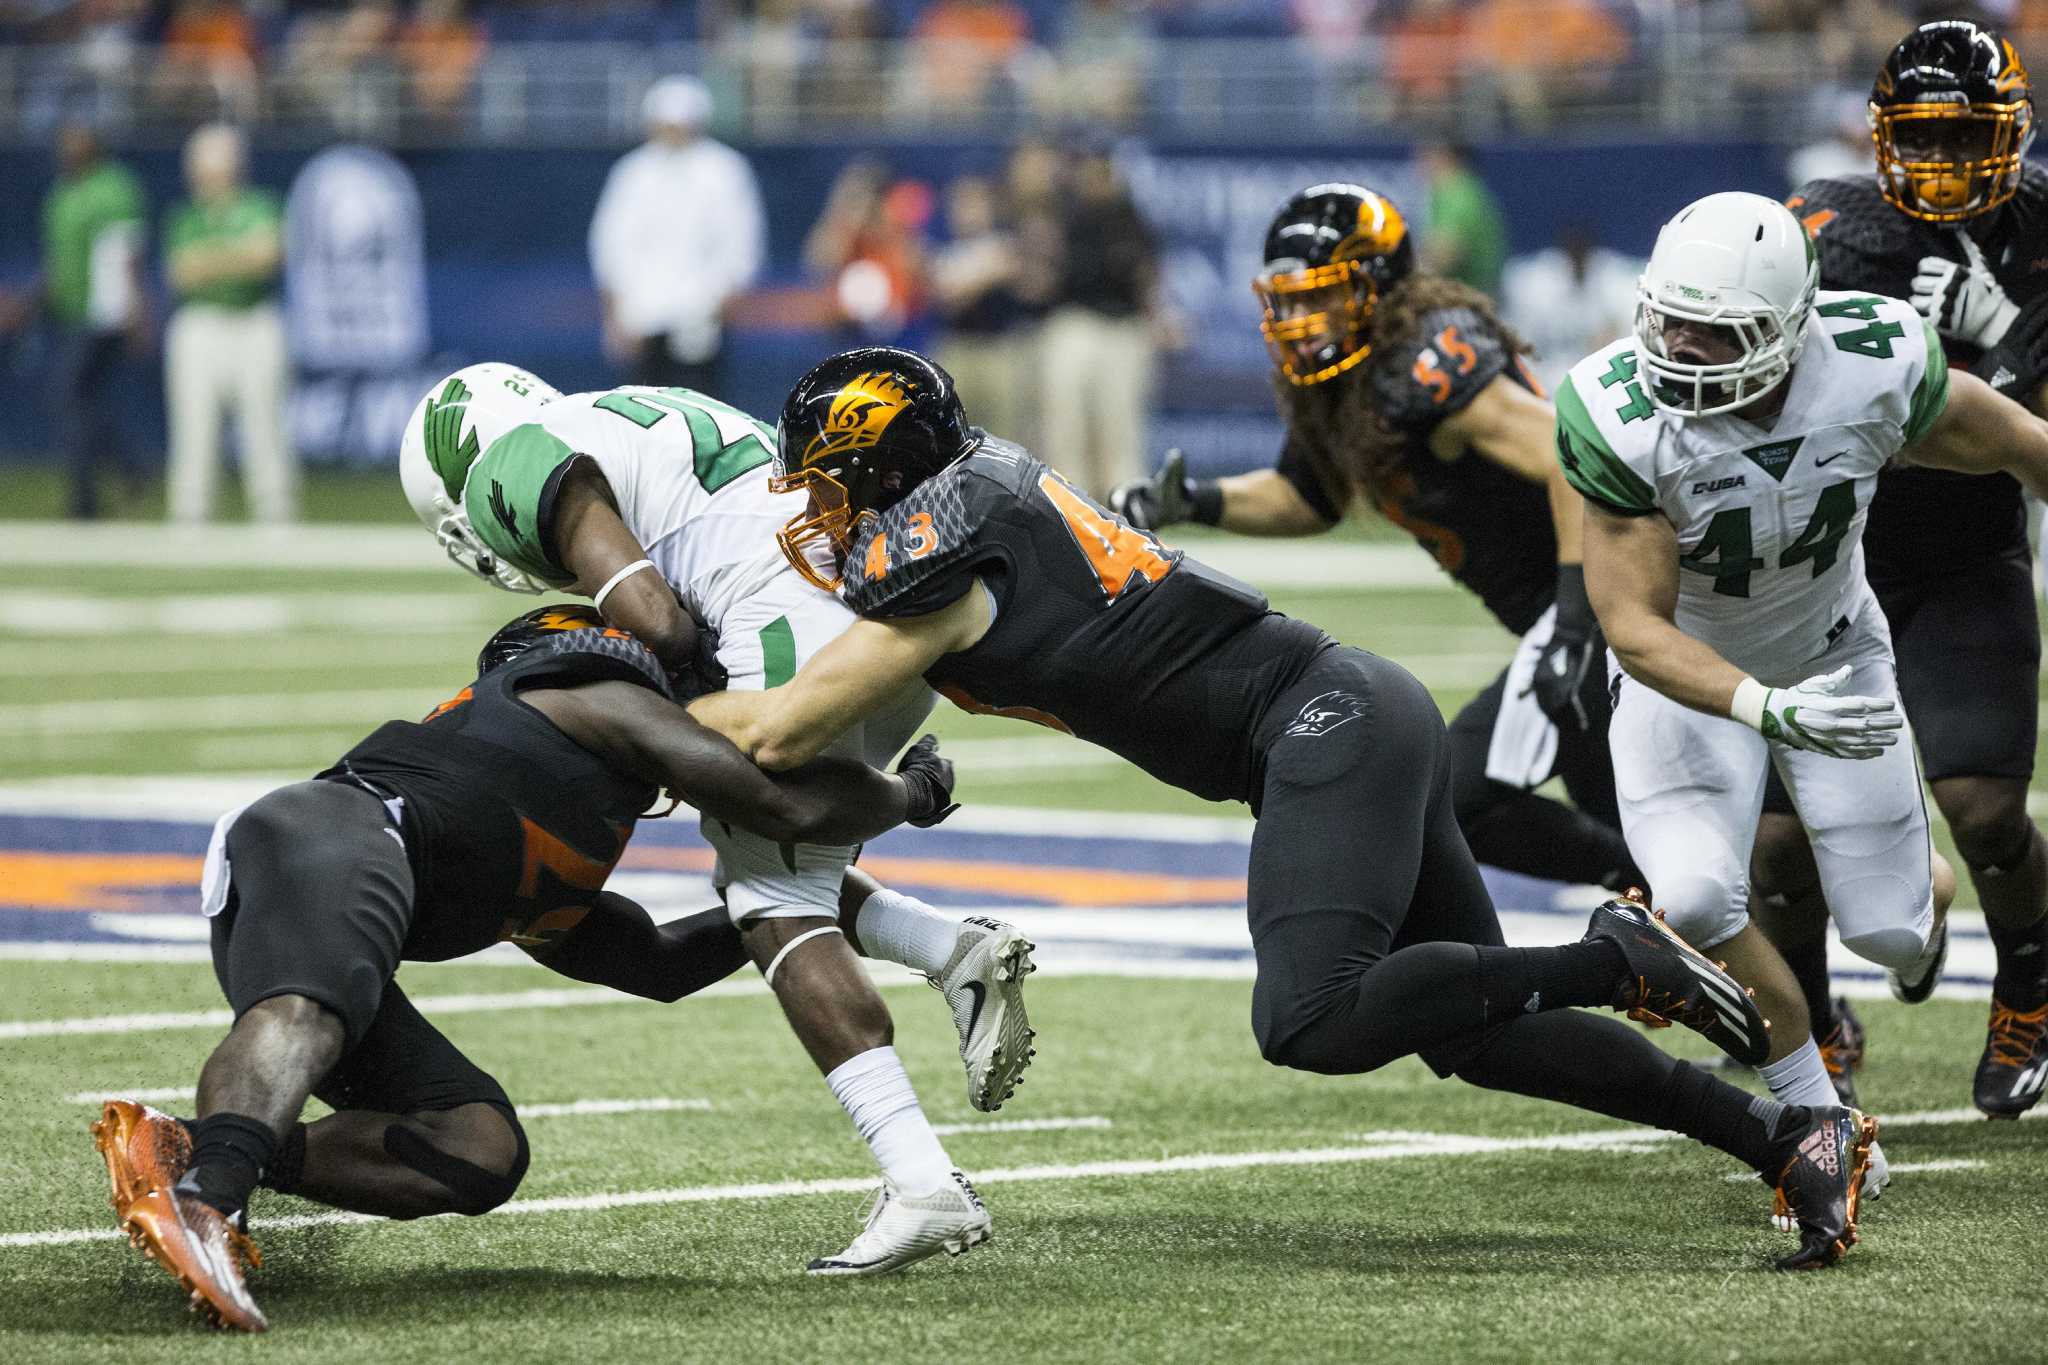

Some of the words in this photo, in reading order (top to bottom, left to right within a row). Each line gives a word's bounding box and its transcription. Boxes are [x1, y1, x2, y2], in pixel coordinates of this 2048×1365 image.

[1412, 324, 1477, 404] 55
[1813, 297, 1906, 359] 44
[864, 511, 940, 583] 43
[1037, 468, 1182, 606] 4
[1679, 478, 1857, 599] 44
[1821, 1118, 1840, 1177] adidas
